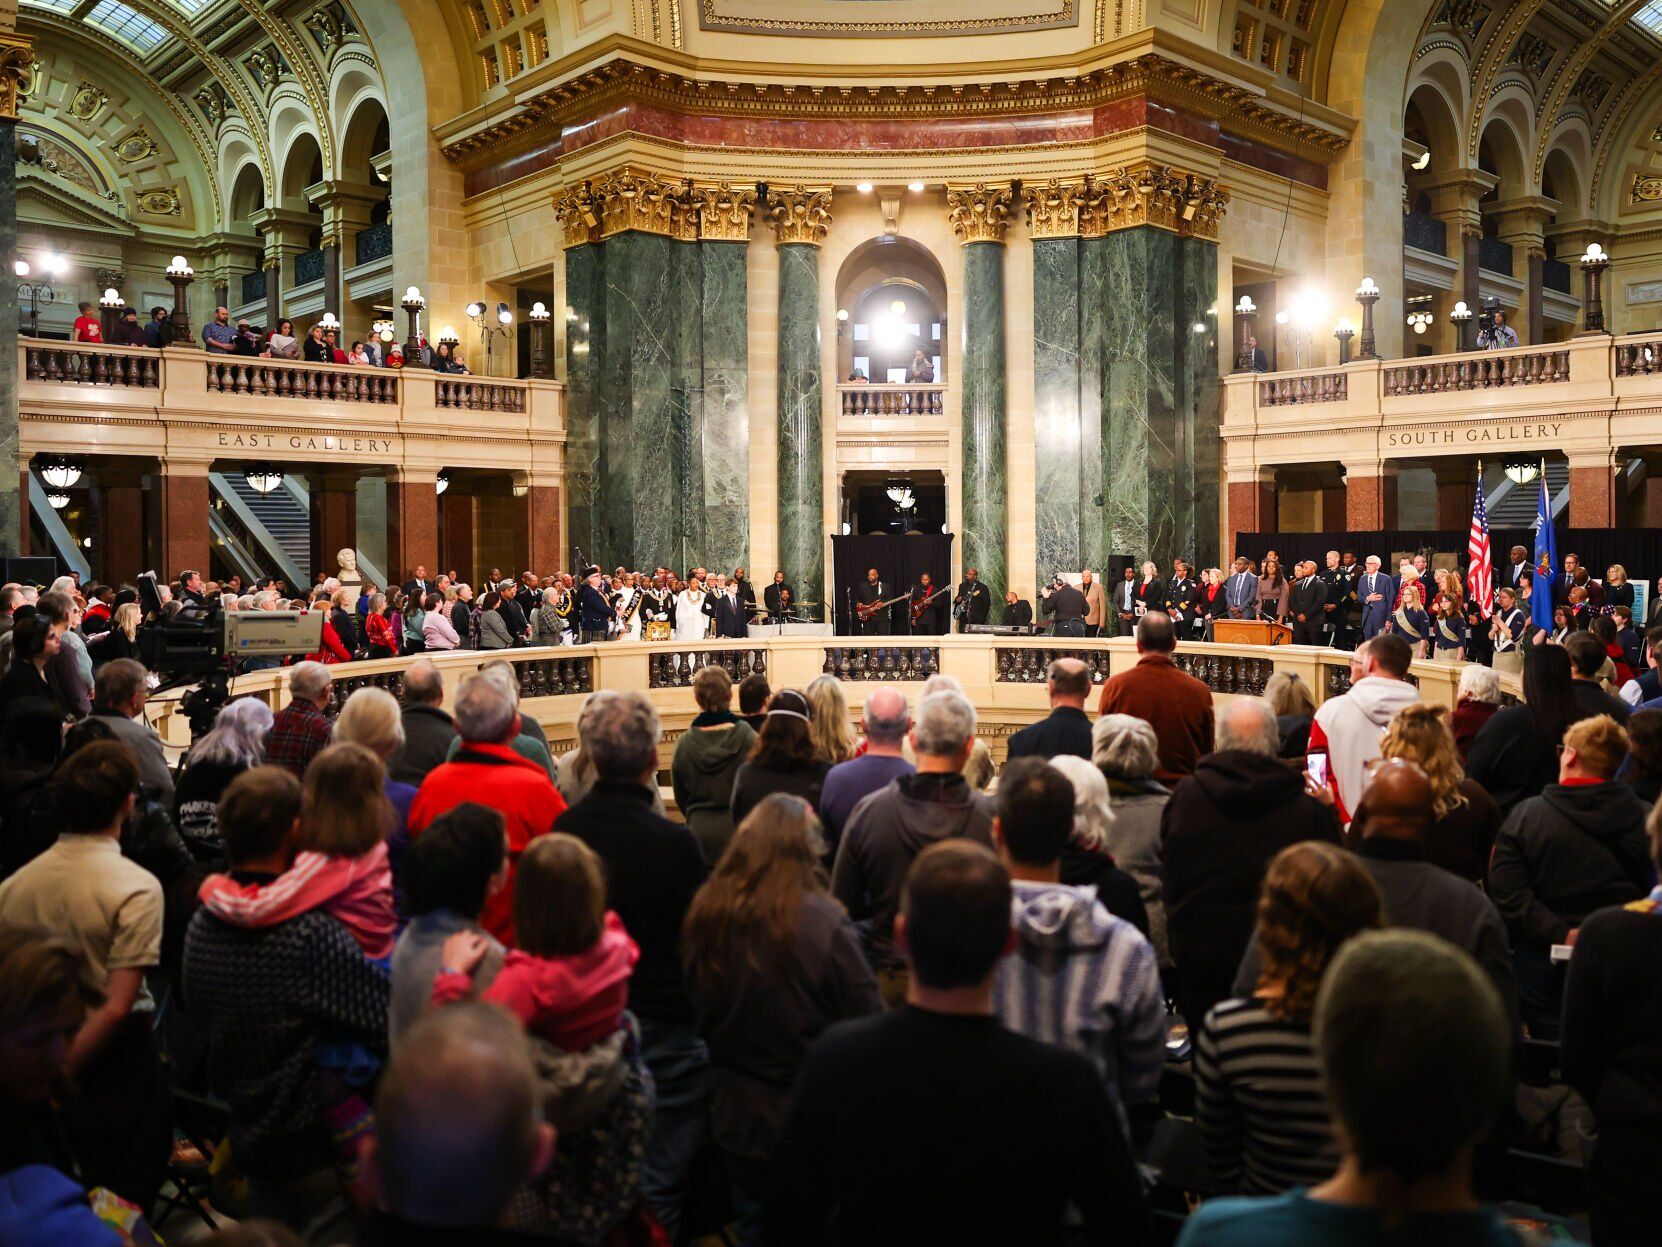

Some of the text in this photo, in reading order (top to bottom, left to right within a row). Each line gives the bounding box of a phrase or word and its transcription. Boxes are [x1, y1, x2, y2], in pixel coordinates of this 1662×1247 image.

[218, 432, 392, 452] EAST GALLERY
[1389, 423, 1562, 446] SOUTH GALLERY
